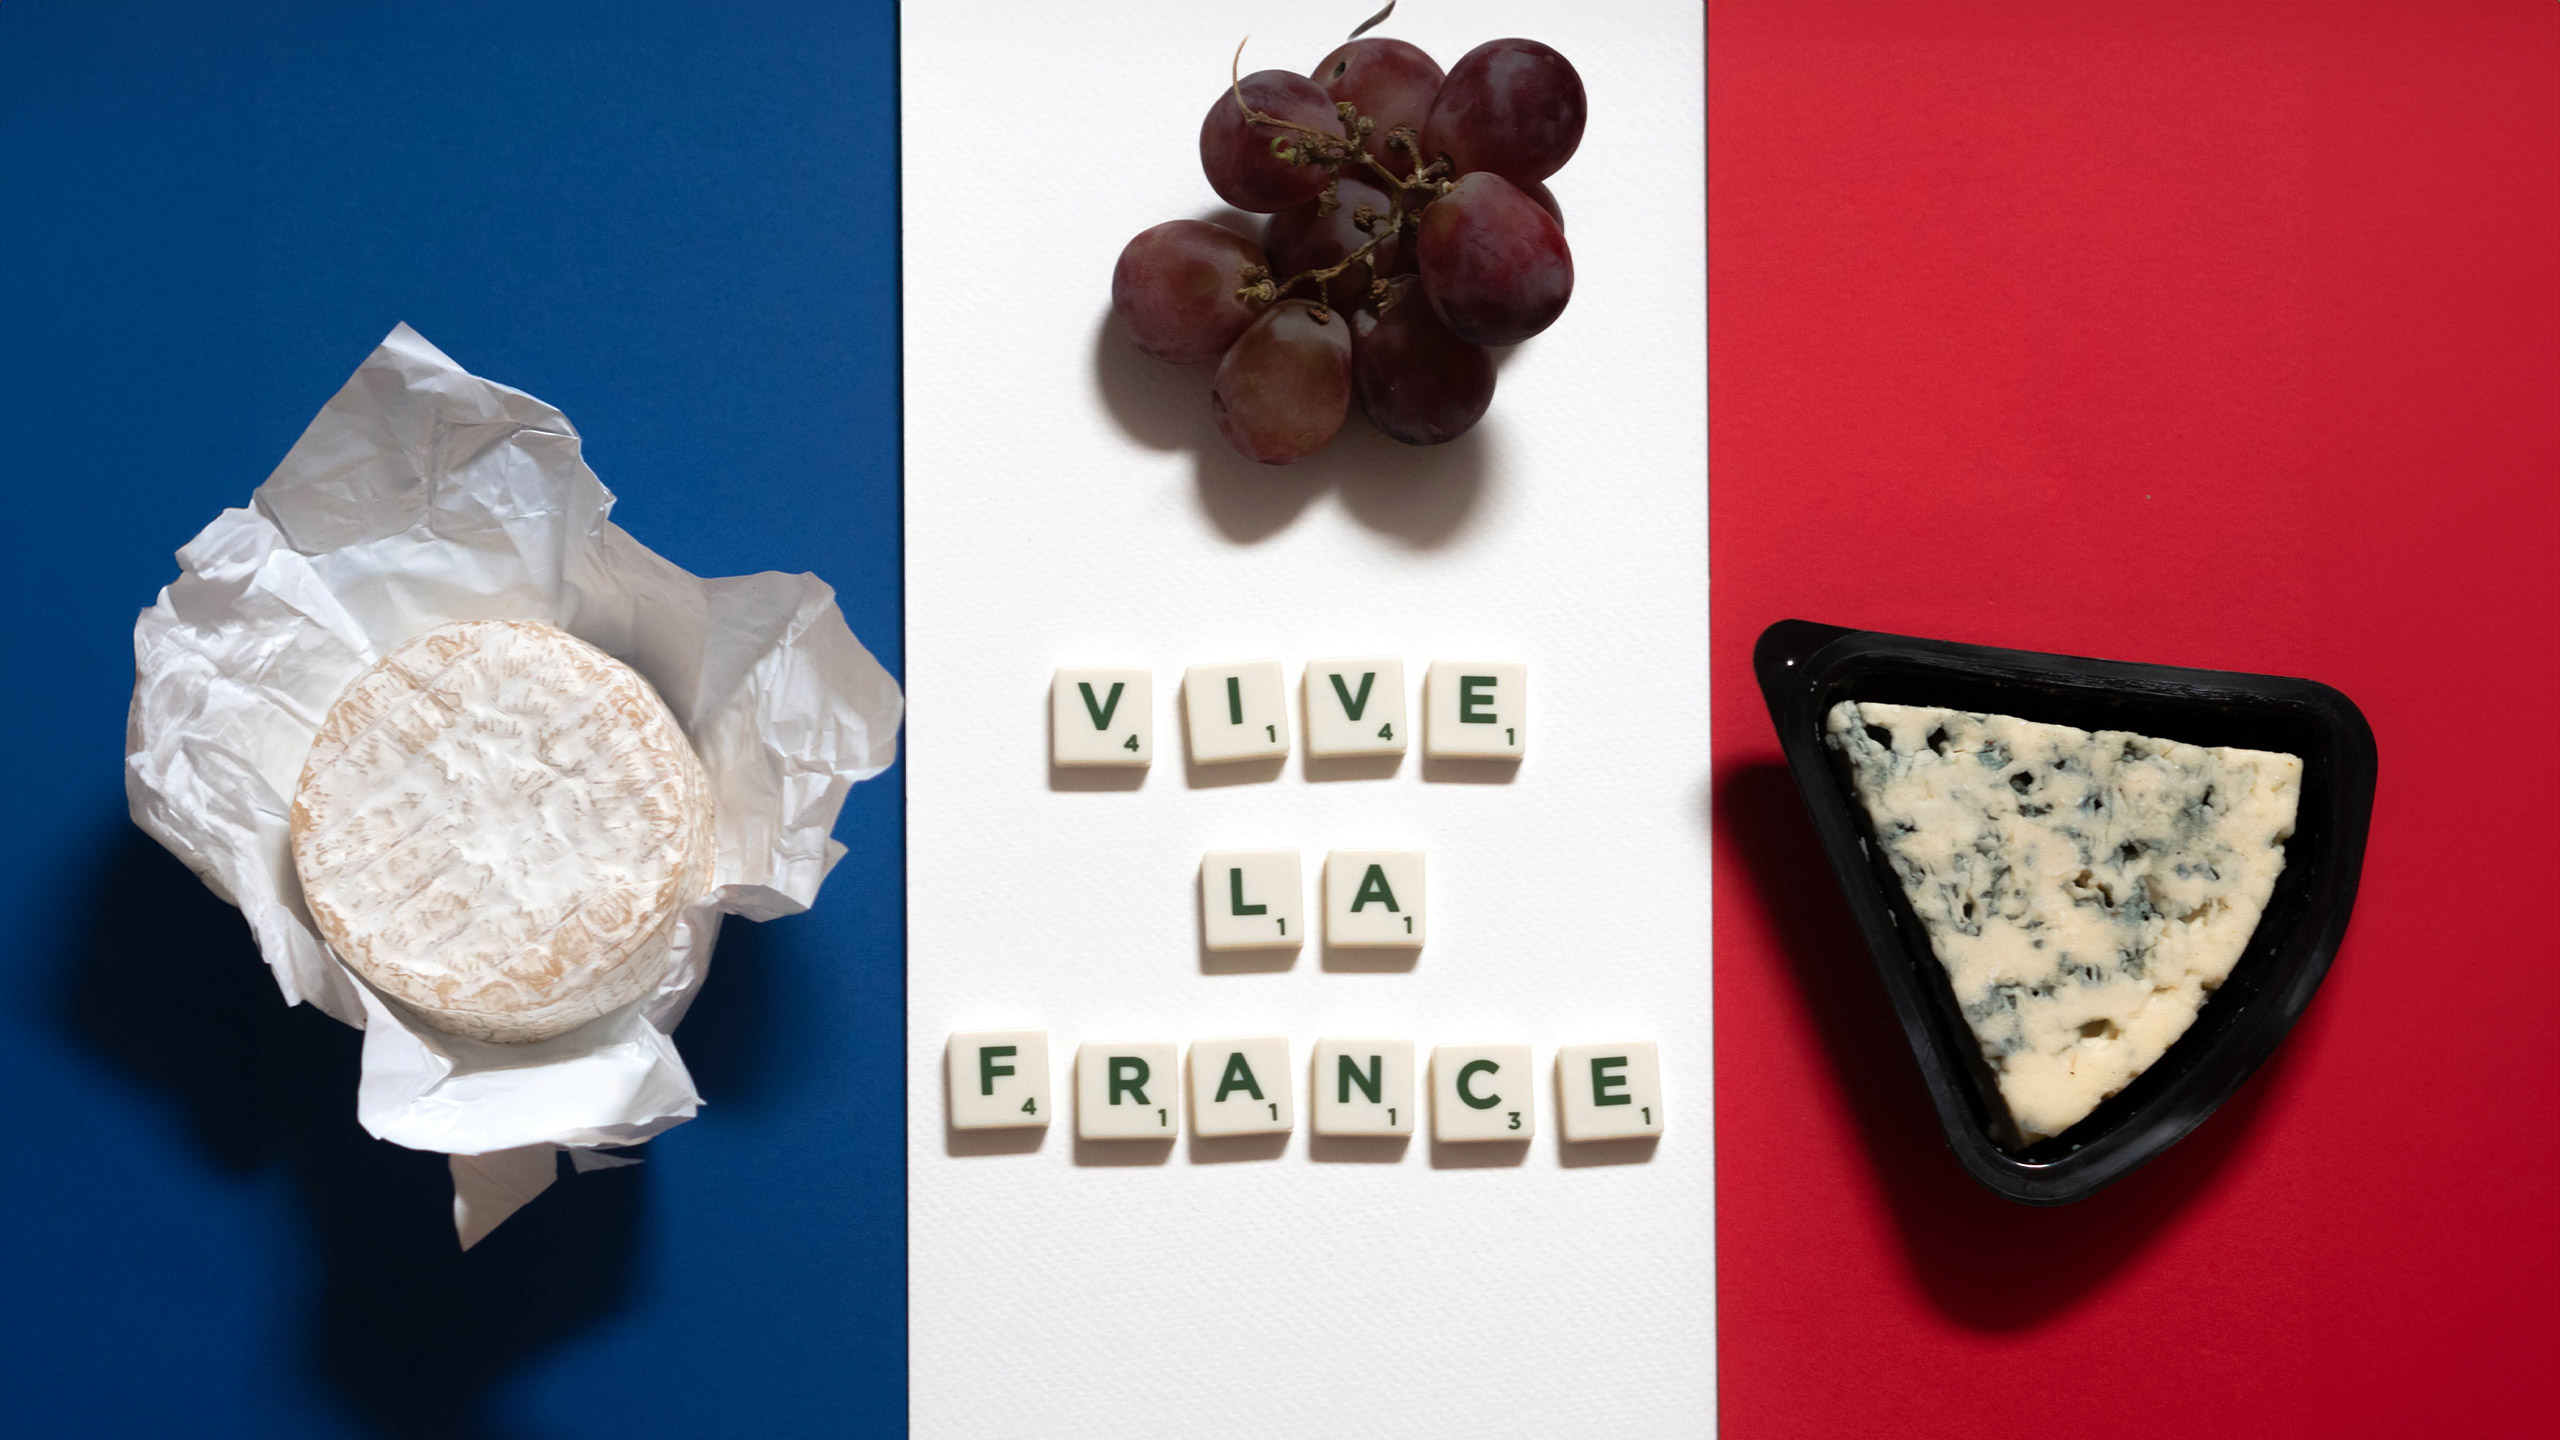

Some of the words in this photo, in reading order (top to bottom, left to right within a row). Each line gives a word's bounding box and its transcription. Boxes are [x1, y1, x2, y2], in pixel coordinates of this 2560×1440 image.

[1123, 733, 1140, 753] 4
[1265, 724, 1276, 743] 1
[1377, 722, 1394, 741] 4
[1505, 727, 1515, 746] 1
[1276, 917, 1286, 936] 1
[1403, 915, 1412, 934] 1
[1020, 1097, 1037, 1116] 4
[1157, 1108, 1167, 1127] 1
[1268, 1102, 1278, 1122] 1
[1387, 1107, 1397, 1126] 1
[1507, 1111, 1522, 1131] 3
[1641, 1106, 1651, 1126] 1
